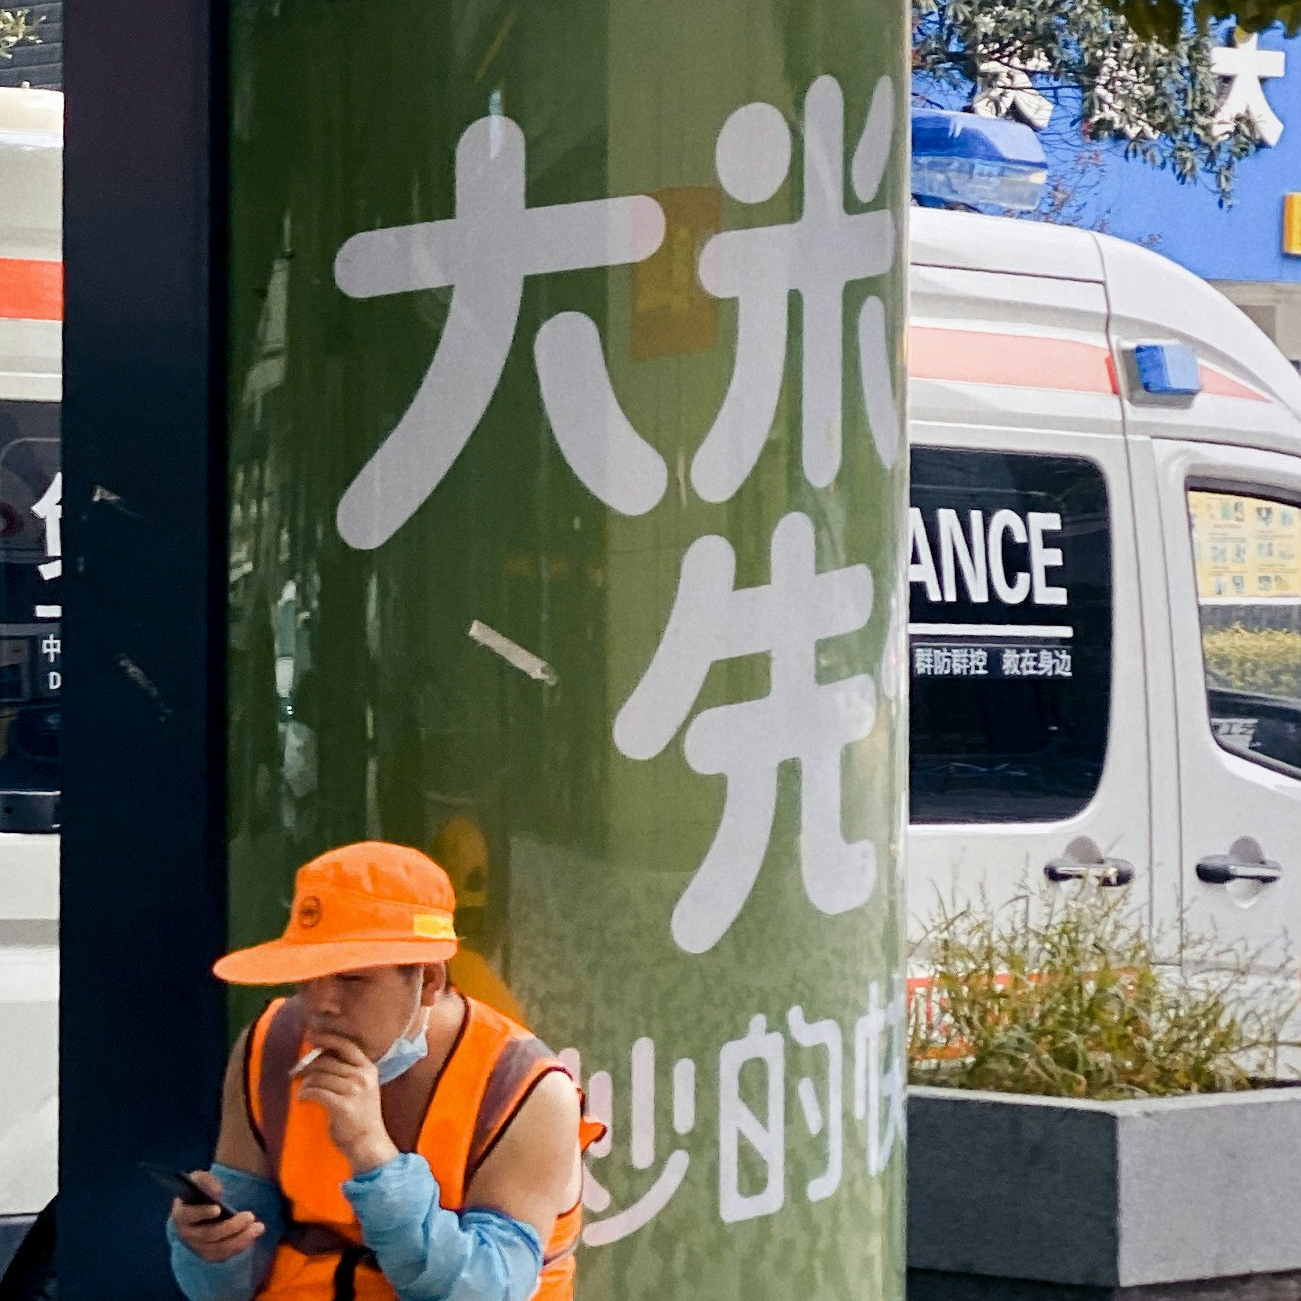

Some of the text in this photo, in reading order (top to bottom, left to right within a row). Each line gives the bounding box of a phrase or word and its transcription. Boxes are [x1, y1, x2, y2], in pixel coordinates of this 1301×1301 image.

[335, 75, 896, 550] 大米
[613, 511, 897, 955] 先
[915, 648, 1074, 677] 群防群控 救在身边
